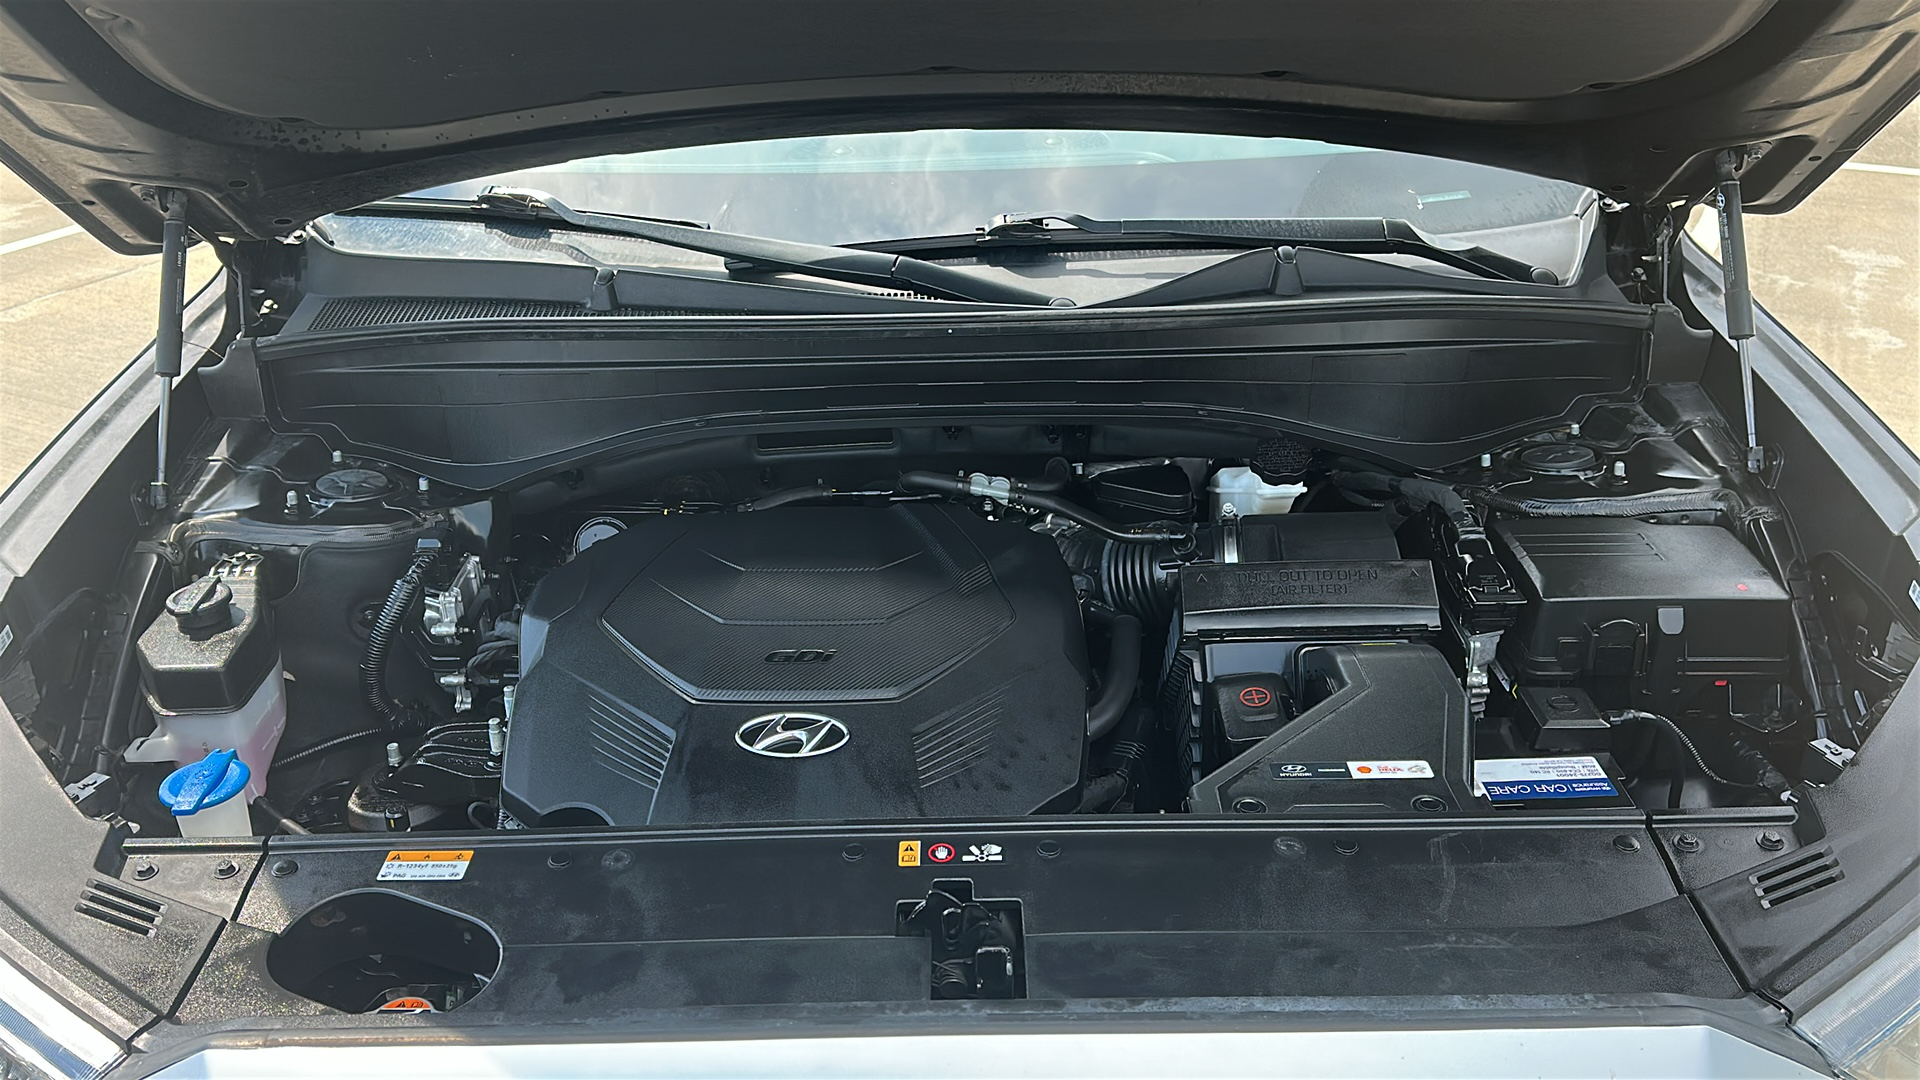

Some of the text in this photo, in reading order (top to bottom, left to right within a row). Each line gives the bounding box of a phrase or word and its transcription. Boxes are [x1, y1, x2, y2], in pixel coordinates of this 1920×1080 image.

[1237, 568, 1378, 583] PULL OUT TO OPEN
[763, 649, 837, 664] GDi
[1487, 784, 1567, 795] CAR CARE
